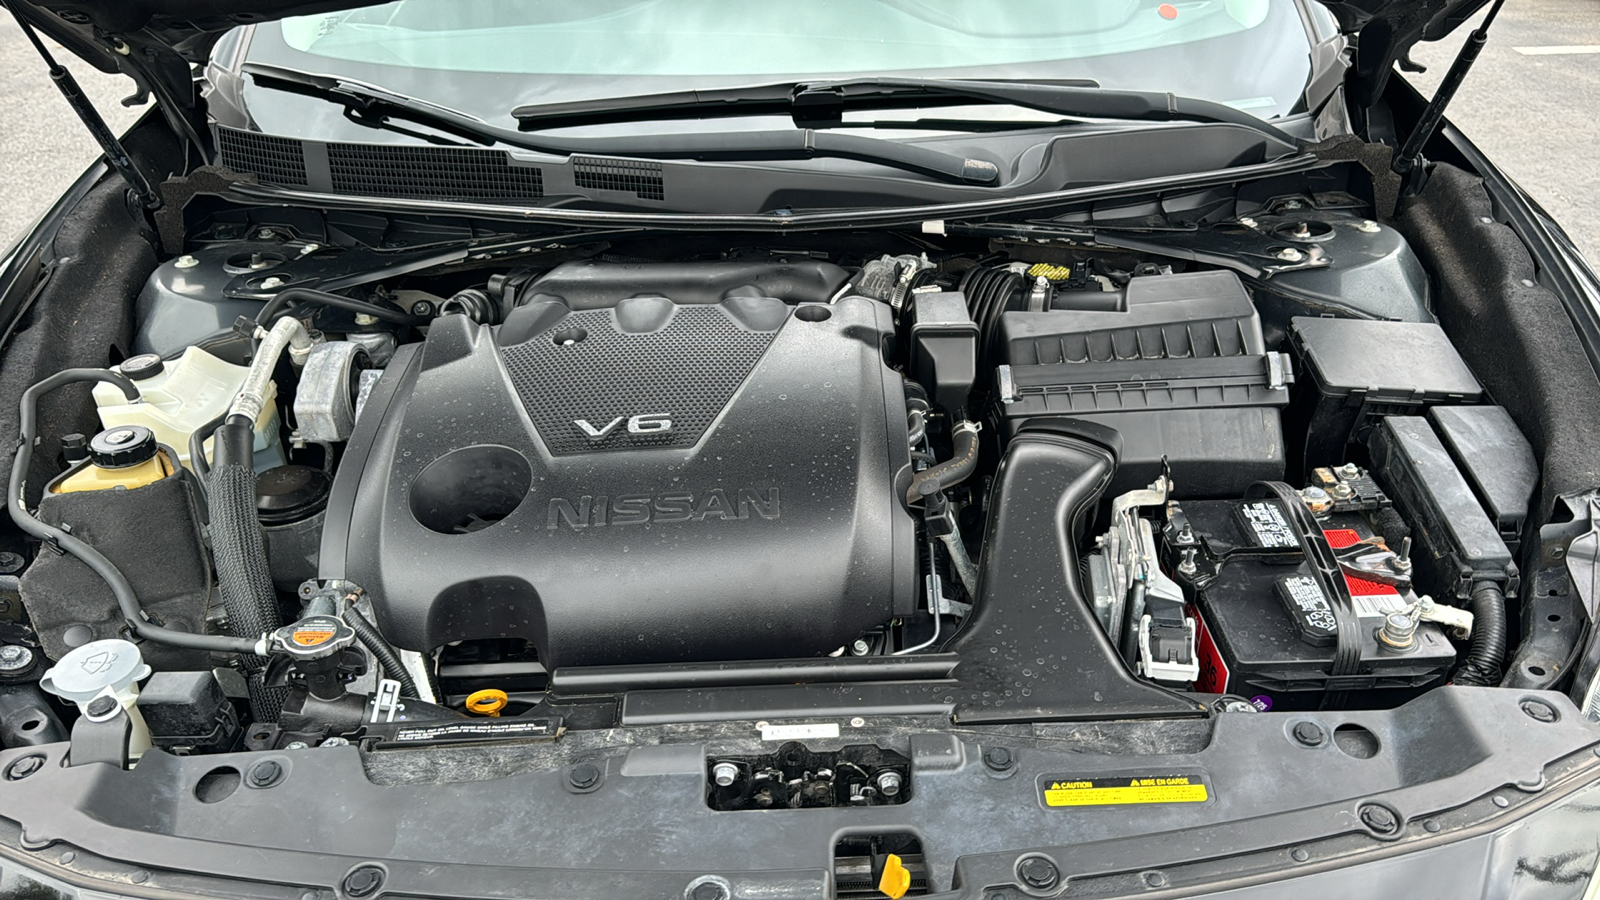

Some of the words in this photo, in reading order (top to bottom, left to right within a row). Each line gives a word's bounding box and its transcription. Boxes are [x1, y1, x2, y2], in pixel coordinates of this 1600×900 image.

[573, 413, 673, 440] V6
[547, 487, 780, 530] NISSAN
[1060, 781, 1093, 790] CAUTION
[1157, 778, 1166, 786] EN
[1166, 777, 1190, 785] GARDE
